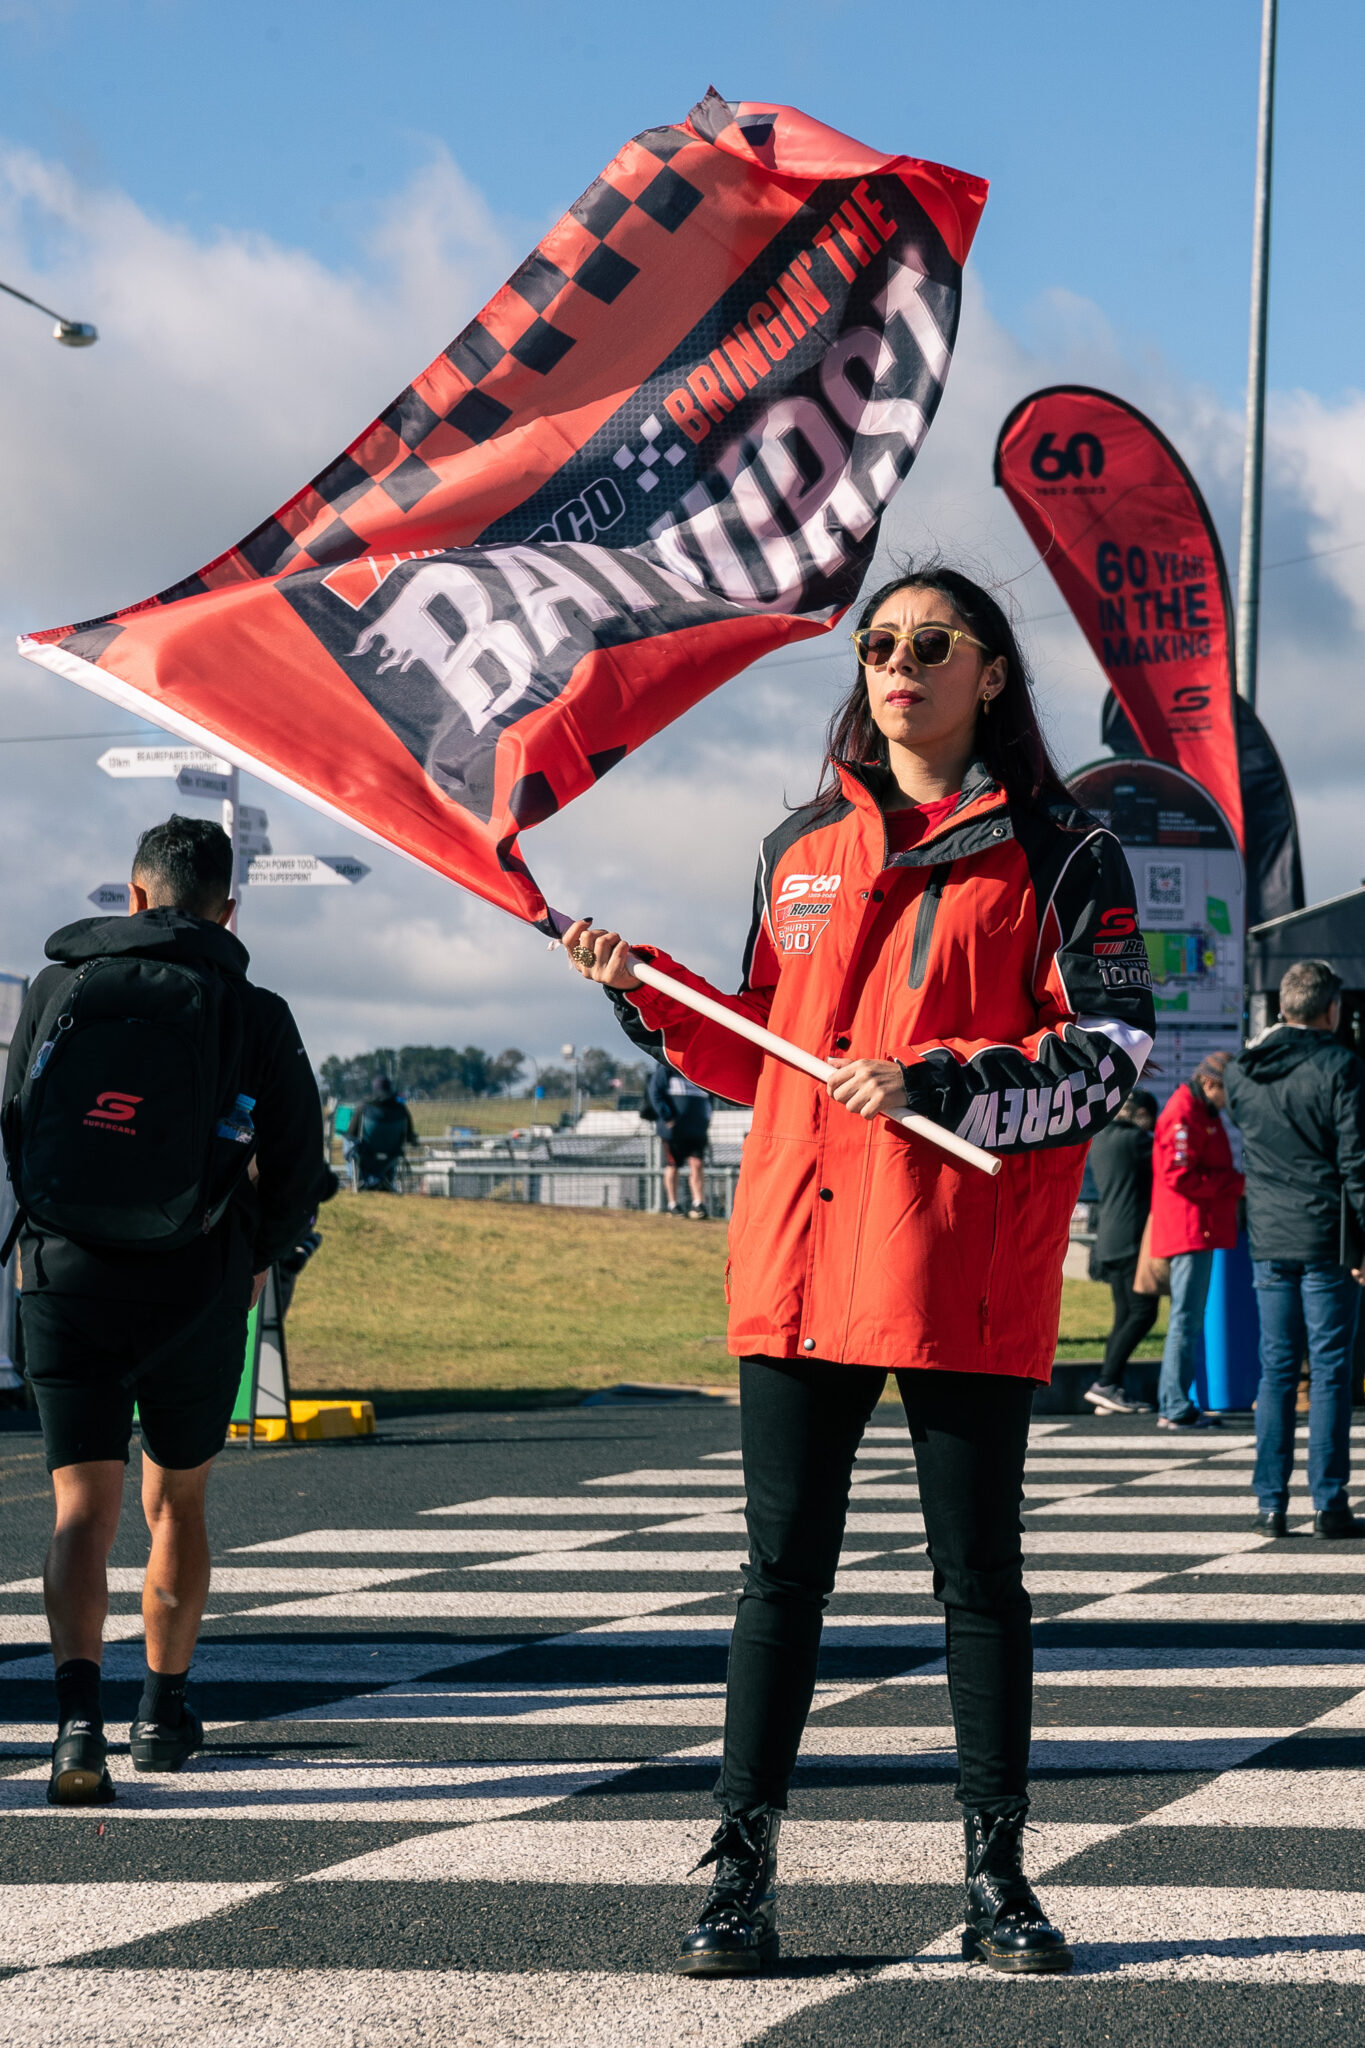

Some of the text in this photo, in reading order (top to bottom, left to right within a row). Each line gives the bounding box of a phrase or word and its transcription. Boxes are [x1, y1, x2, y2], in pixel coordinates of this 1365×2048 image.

[662, 178, 898, 444] BRINGIN' THE
[1096, 541, 1206, 594] 60 YEARS
[1099, 582, 1210, 631] IN THE
[1102, 633, 1211, 668] MAKING
[269, 873, 312, 882] SUPERSPRINT
[273, 860, 295, 869] POWER
[298, 860, 318, 869] TOOLS
[790, 903, 832, 918] Repco
[82, 1119, 136, 1136] SUPERCARS
[955, 1079, 1074, 1148] CREW
